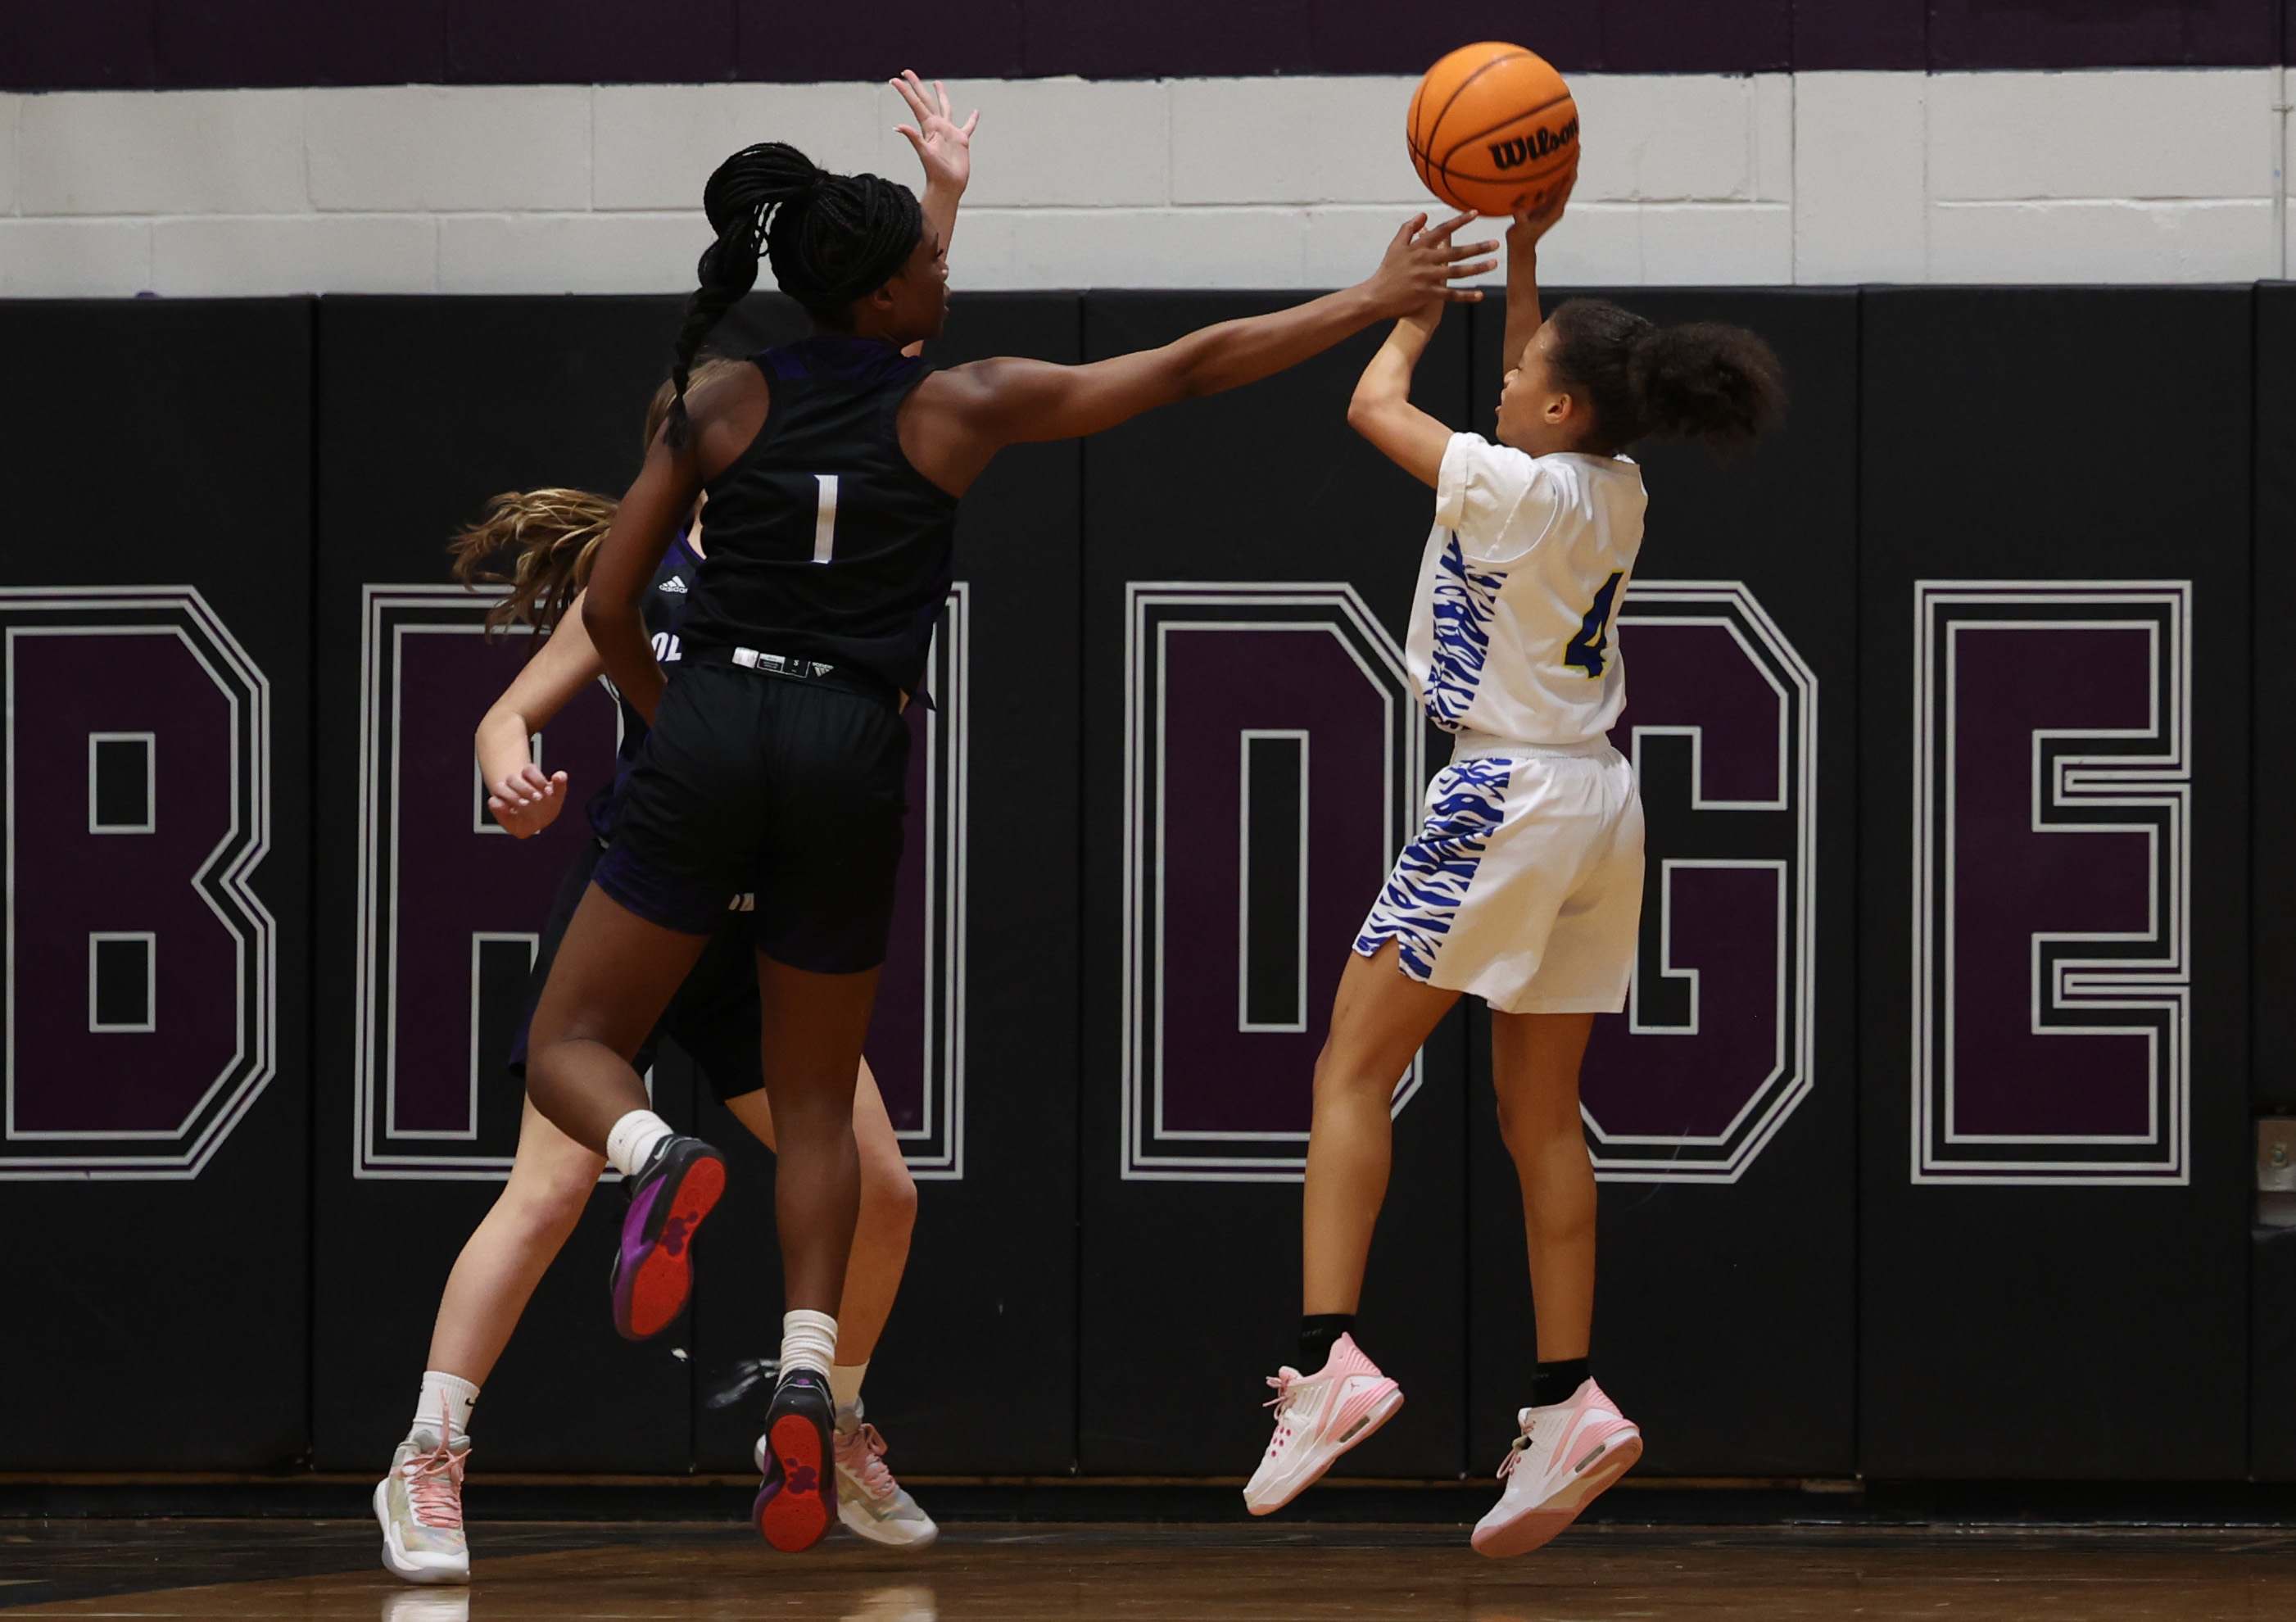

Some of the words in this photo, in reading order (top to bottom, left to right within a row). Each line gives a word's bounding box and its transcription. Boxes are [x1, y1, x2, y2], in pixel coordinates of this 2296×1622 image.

[1488, 117, 1578, 170] Wilson
[811, 474, 839, 564] 1
[1563, 569, 1625, 680] 4
